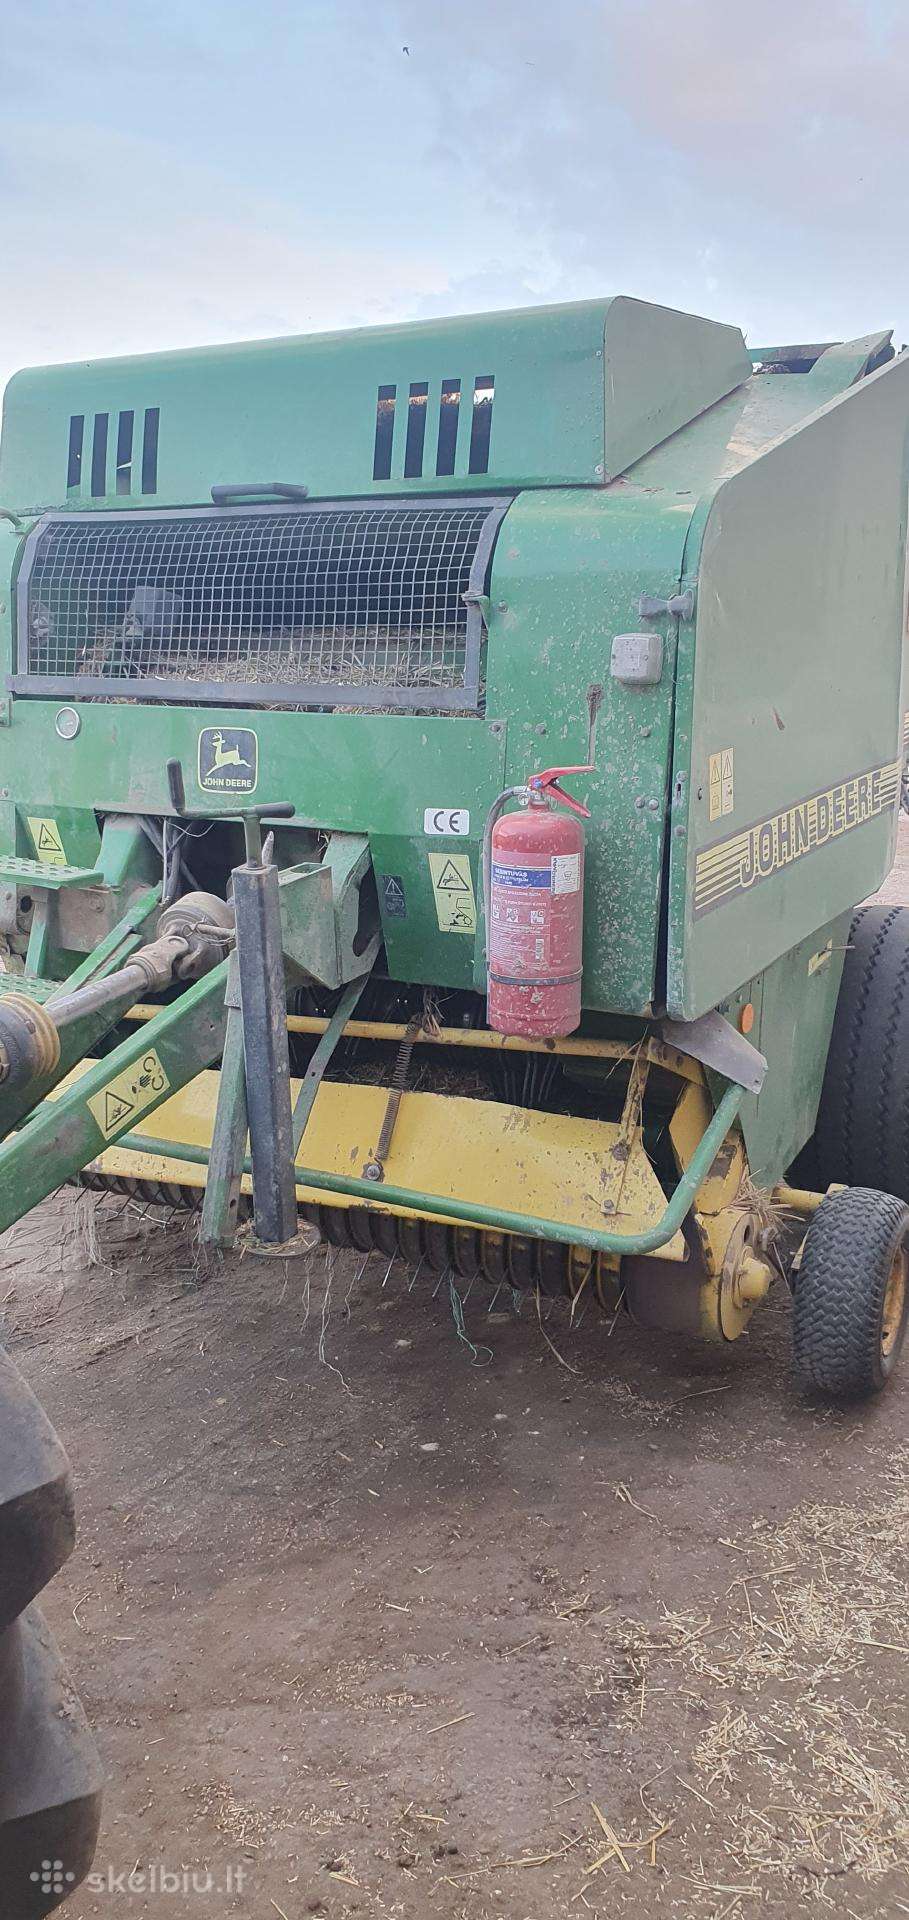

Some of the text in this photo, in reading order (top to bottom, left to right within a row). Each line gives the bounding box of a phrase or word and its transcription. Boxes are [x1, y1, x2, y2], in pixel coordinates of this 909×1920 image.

[203, 778, 252, 788] JOHN DEERE
[433, 811, 461, 833] CE
[739, 770, 883, 888] JOHN DEERE
